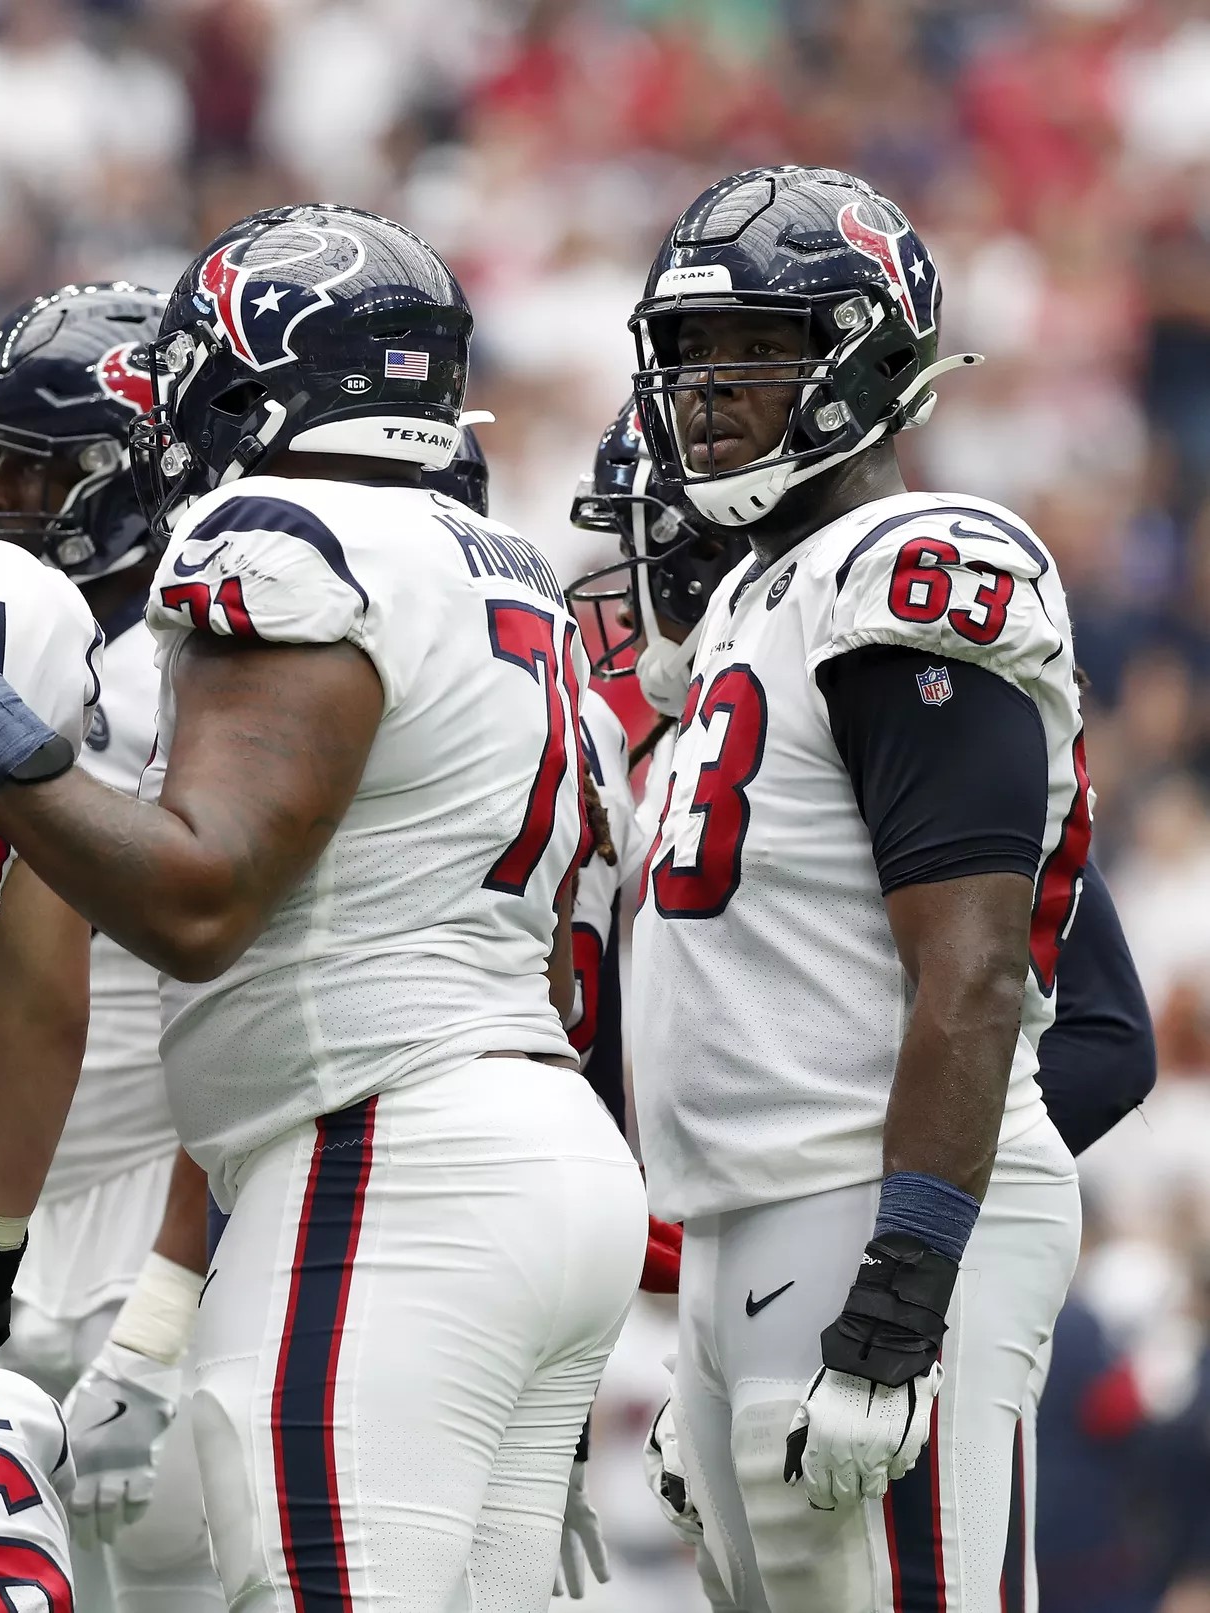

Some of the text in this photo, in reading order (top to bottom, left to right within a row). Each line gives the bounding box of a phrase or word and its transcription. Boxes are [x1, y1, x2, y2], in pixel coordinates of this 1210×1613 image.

[431, 514, 564, 610] HOWARD
[888, 536, 1015, 646] 63
[160, 575, 260, 639] 71
[922, 681, 949, 701] NFL
